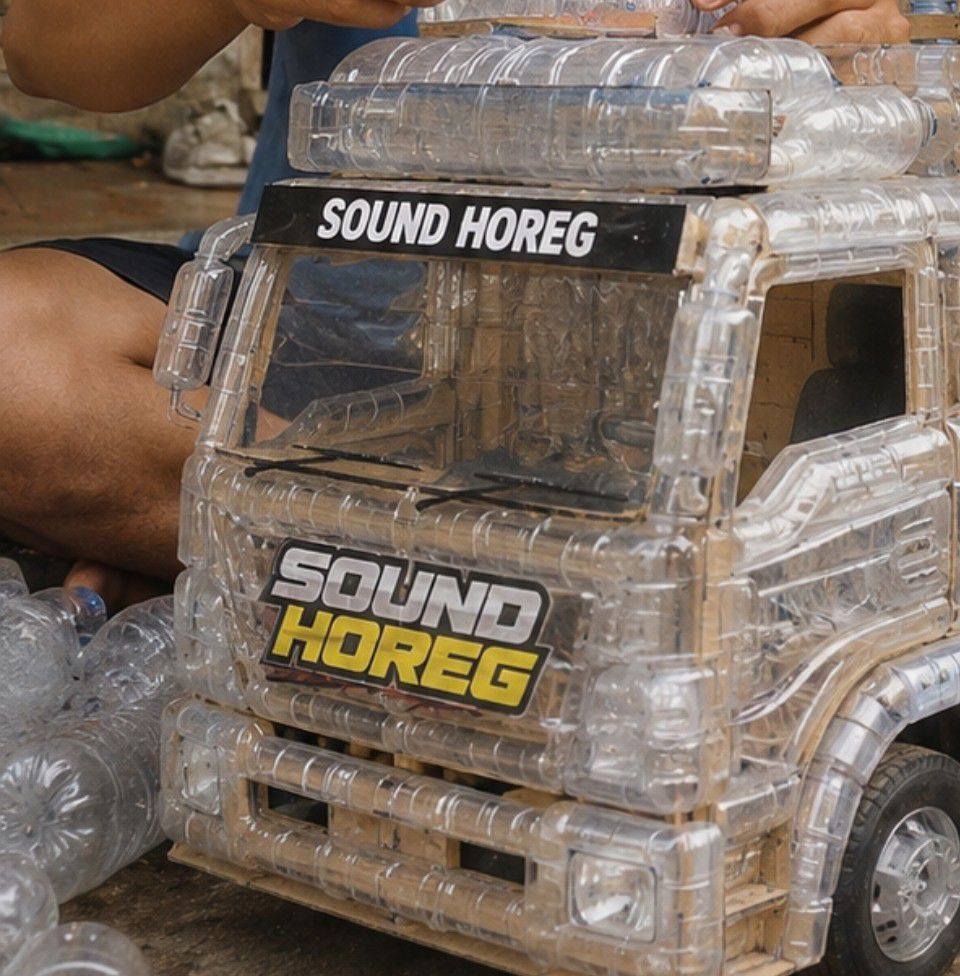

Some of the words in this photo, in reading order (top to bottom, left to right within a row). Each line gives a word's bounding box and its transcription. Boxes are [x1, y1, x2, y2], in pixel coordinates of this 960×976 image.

[317, 197, 450, 246] SOUND
[455, 205, 598, 258] HOREG
[270, 547, 543, 644] SOUND
[271, 605, 539, 707] HOREG
